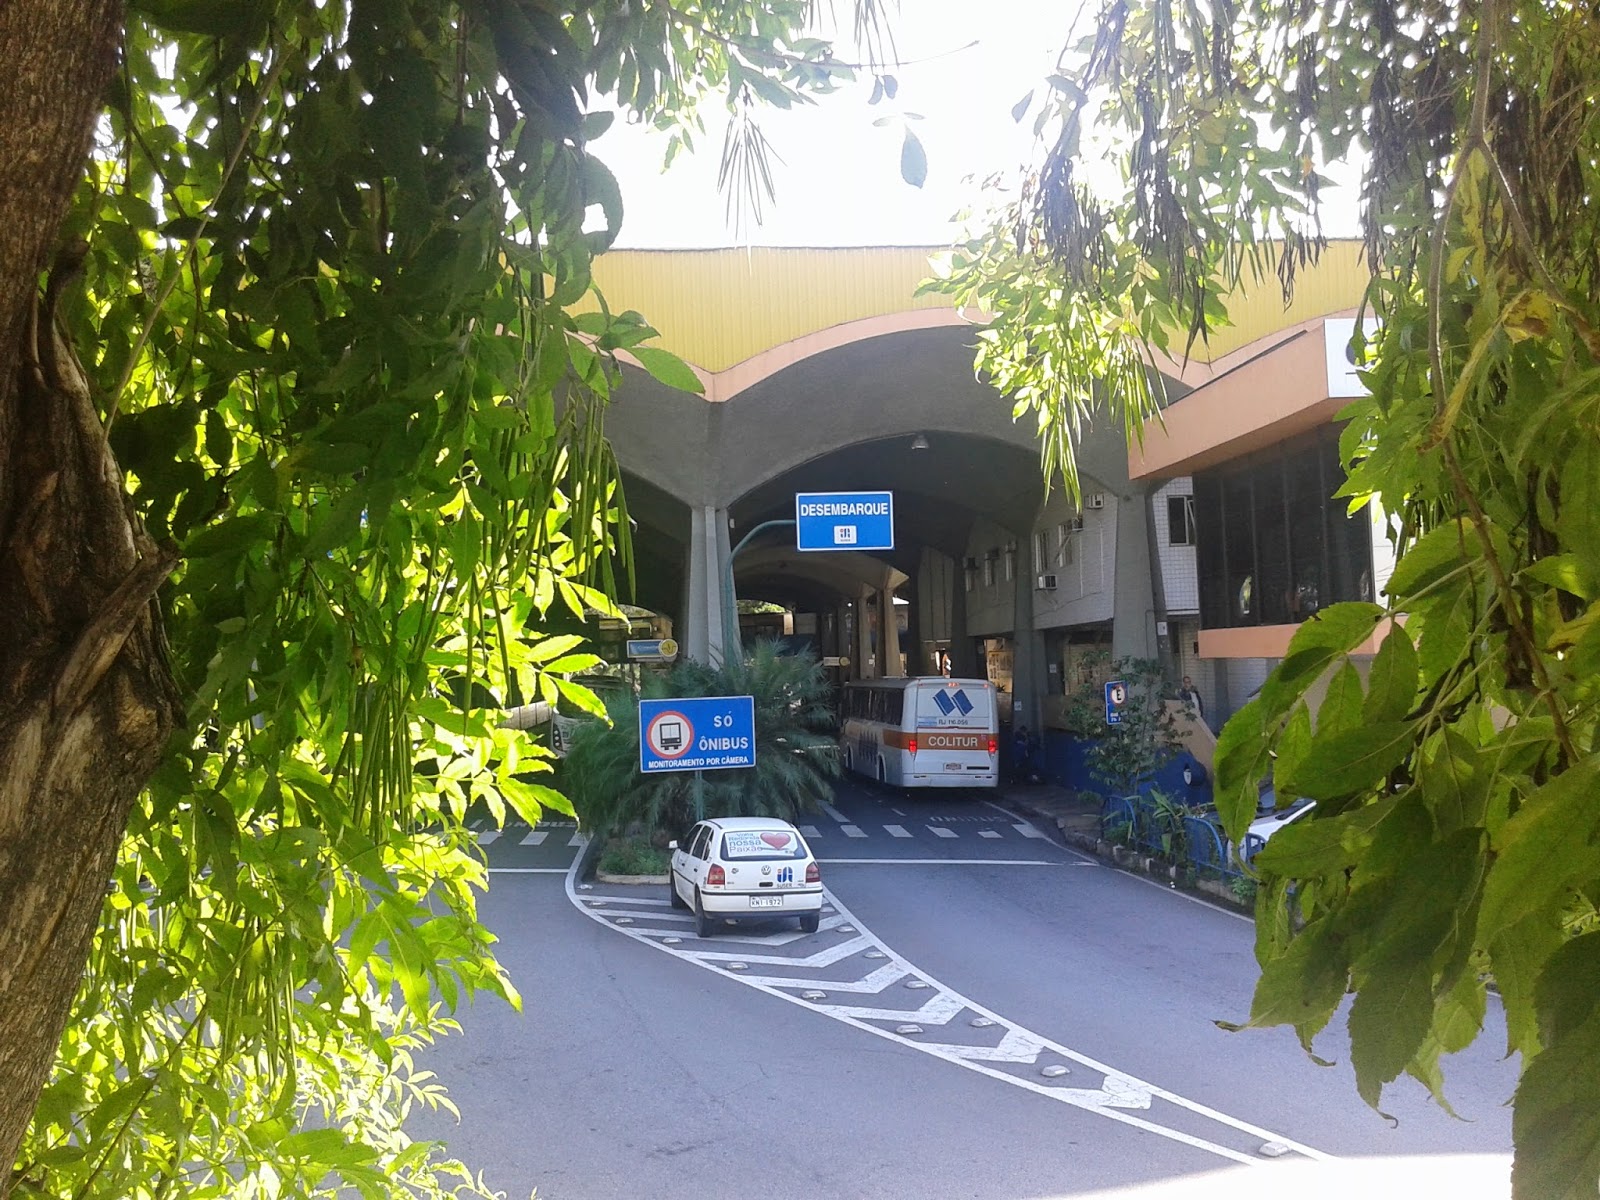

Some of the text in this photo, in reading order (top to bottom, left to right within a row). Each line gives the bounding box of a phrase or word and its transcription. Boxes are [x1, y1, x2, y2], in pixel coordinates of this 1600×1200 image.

[800, 502, 889, 517] DESEMBARQUE
[713, 710, 733, 728] SÓ
[698, 736, 749, 751] ÔNIBUS
[928, 736, 978, 747] COLITUR
[648, 755, 749, 768] MONITORAMENTO POR CÂMERA
